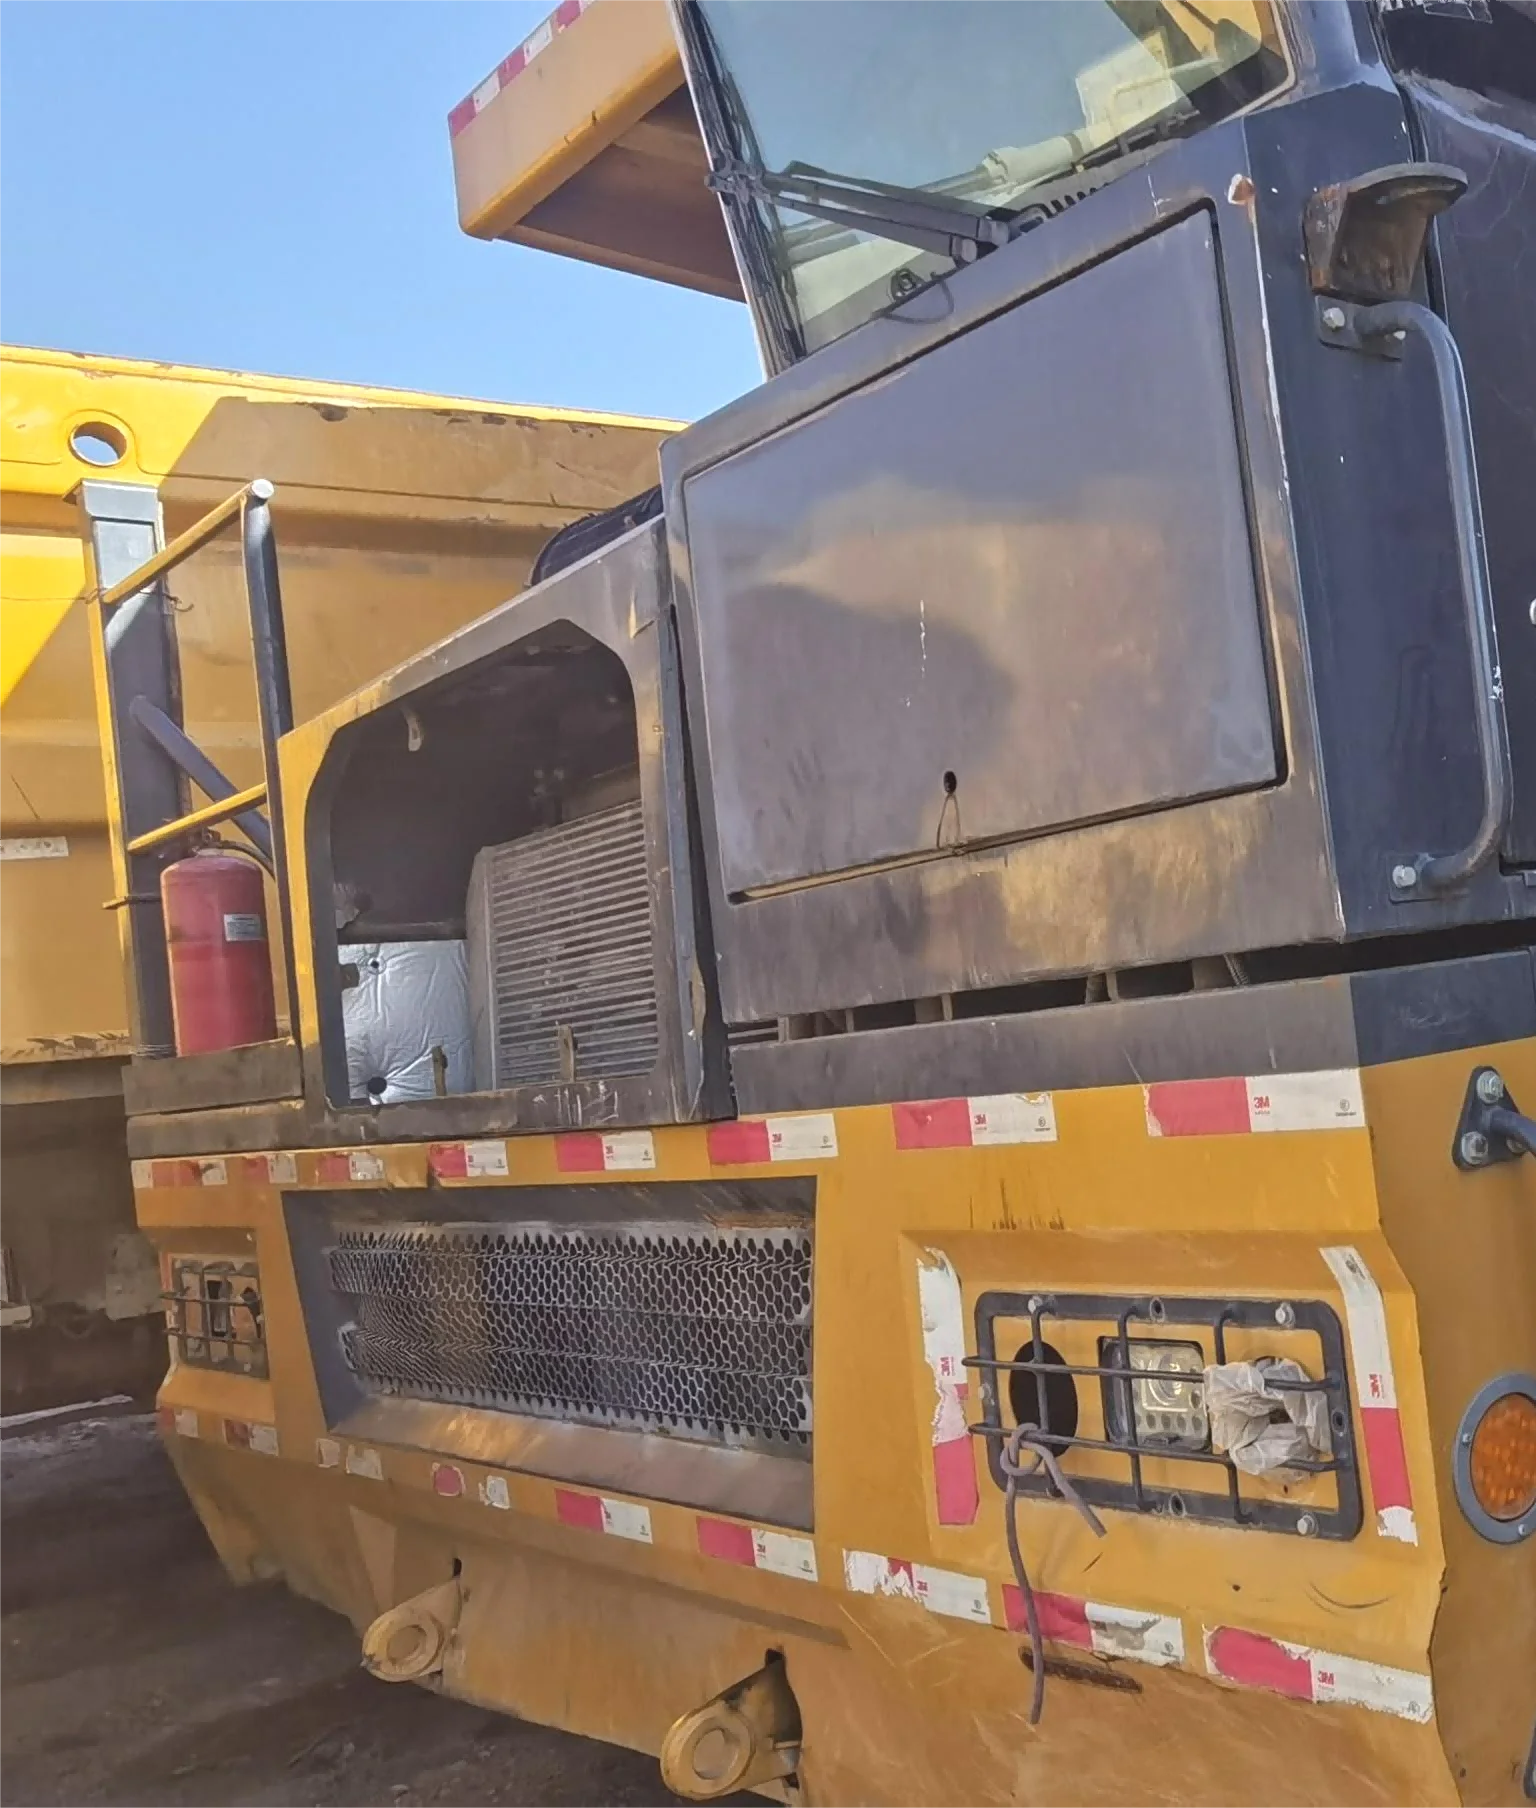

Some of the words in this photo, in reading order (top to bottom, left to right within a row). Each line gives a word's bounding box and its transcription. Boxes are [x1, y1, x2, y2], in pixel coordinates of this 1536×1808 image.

[1254, 1095, 1270, 1109] 3M
[1369, 1373, 1381, 1399] 3M
[1317, 1670, 1335, 1686] 3M
